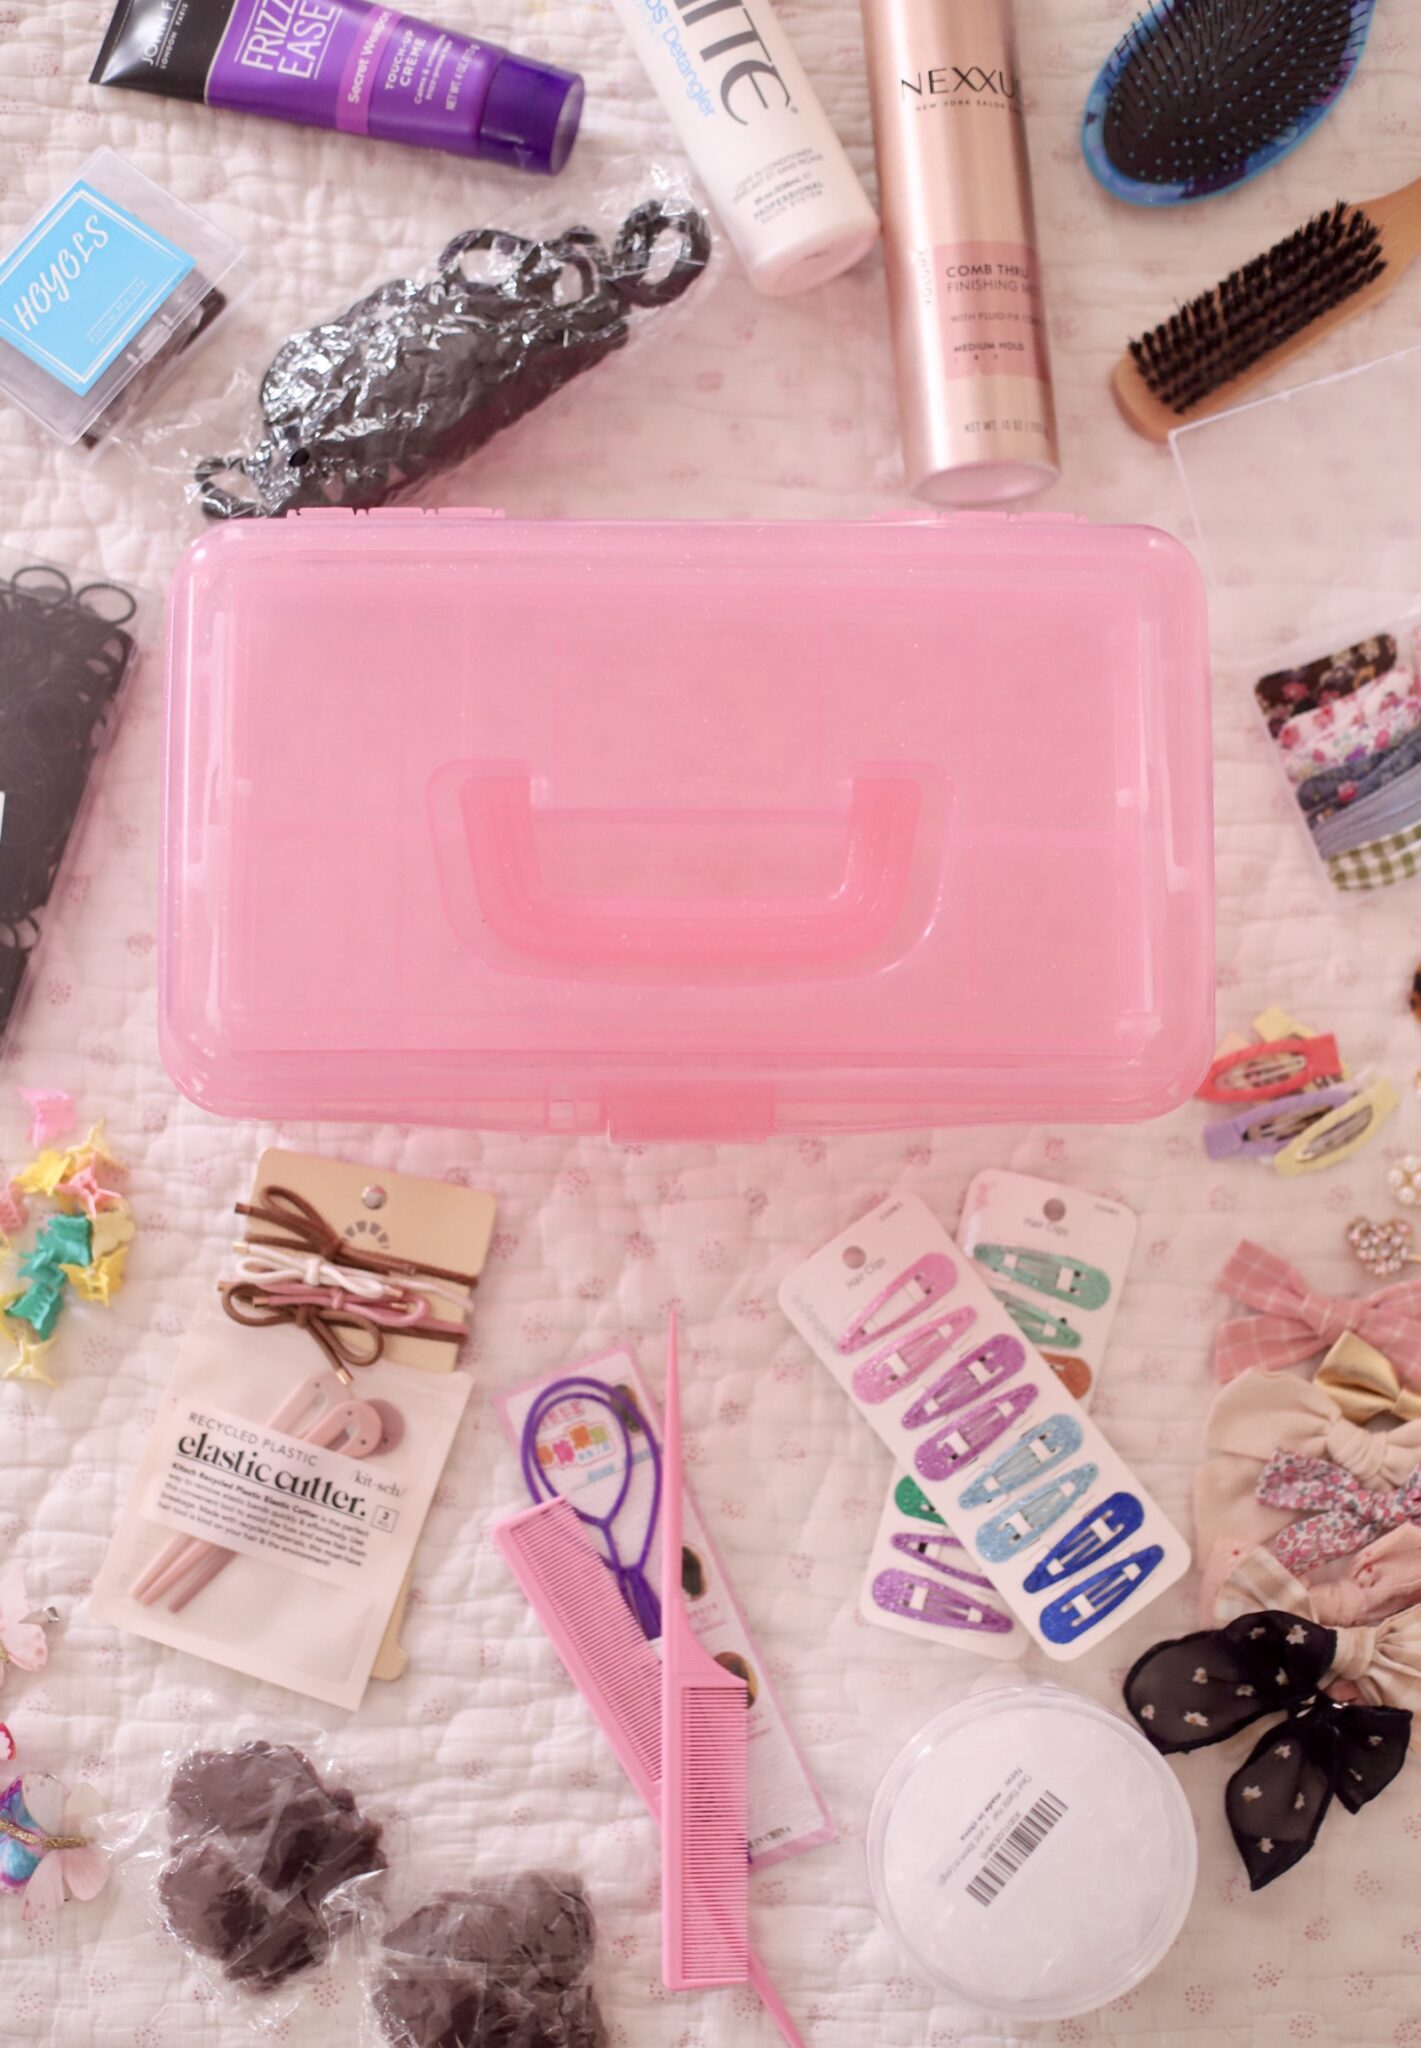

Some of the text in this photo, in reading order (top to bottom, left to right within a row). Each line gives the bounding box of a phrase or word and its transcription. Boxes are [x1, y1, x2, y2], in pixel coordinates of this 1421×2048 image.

[160, 3, 189, 69] LONDON PARIS
[278, 5, 334, 79] EASE
[347, 10, 393, 104] Secret Weapon
[384, 29, 414, 91] TOUCH-UP
[662, 26, 717, 118] Detangler
[902, 66, 1019, 101] NEXXU
[915, 103, 937, 111] NEW
[943, 99, 970, 107] YORK
[13, 215, 110, 331] HOYOLS
[945, 263, 993, 278] COMB
[946, 278, 1018, 294] FINISHING
[950, 313, 976, 323] WITH
[953, 341, 1025, 353] MEDIUM HOLD
[1023, 1217, 1069, 1237] Hair Clips
[845, 1256, 887, 1289] Hair Clips
[188, 1411, 318, 1468] RECYCLED PLASTIC
[177, 1432, 366, 1517] elastic cutter.
[194, 1482, 221, 1497] remove
[221, 1493, 245, 1506] elastic
[246, 1500, 270, 1515] bands
[270, 1510, 298, 1524] quickly
[198, 1471, 234, 1490] Recycled
[235, 1485, 262, 1501] Plastic
[263, 1495, 290, 1510] Elastic
[292, 1505, 319, 1519] Cutter
[341, 1524, 369, 1537] perfect
[179, 1489, 220, 1507] convenient
[245, 1512, 268, 1524] avoid
[314, 1536, 332, 1546] save
[348, 1546, 367, 1558] from
[196, 1515, 214, 1527] kind
[224, 1527, 243, 1537] your
[198, 1504, 220, 1518] Made
[221, 1515, 238, 1524] with
[238, 1520, 271, 1536] recycled
[323, 1549, 362, 1567] must-have
[1004, 1767, 1023, 1787] New
[984, 1792, 1002, 1813] made
[959, 1820, 978, 1841] china
